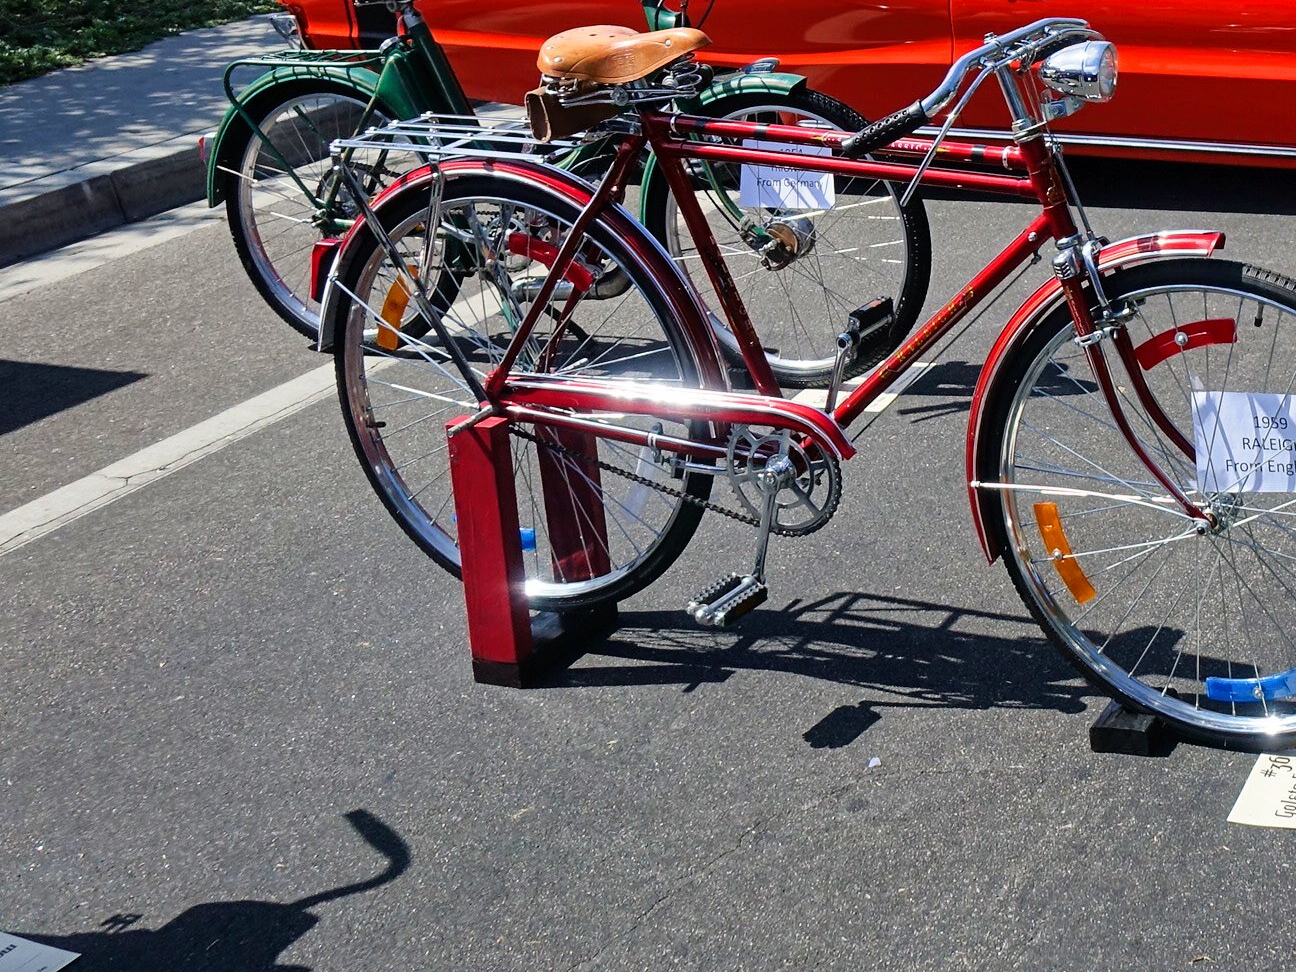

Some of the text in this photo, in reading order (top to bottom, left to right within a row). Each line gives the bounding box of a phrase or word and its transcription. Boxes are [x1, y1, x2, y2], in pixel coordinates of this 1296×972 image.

[757, 177, 781, 188] From
[1253, 415, 1288, 430] 1959
[1226, 459, 1263, 473] From
